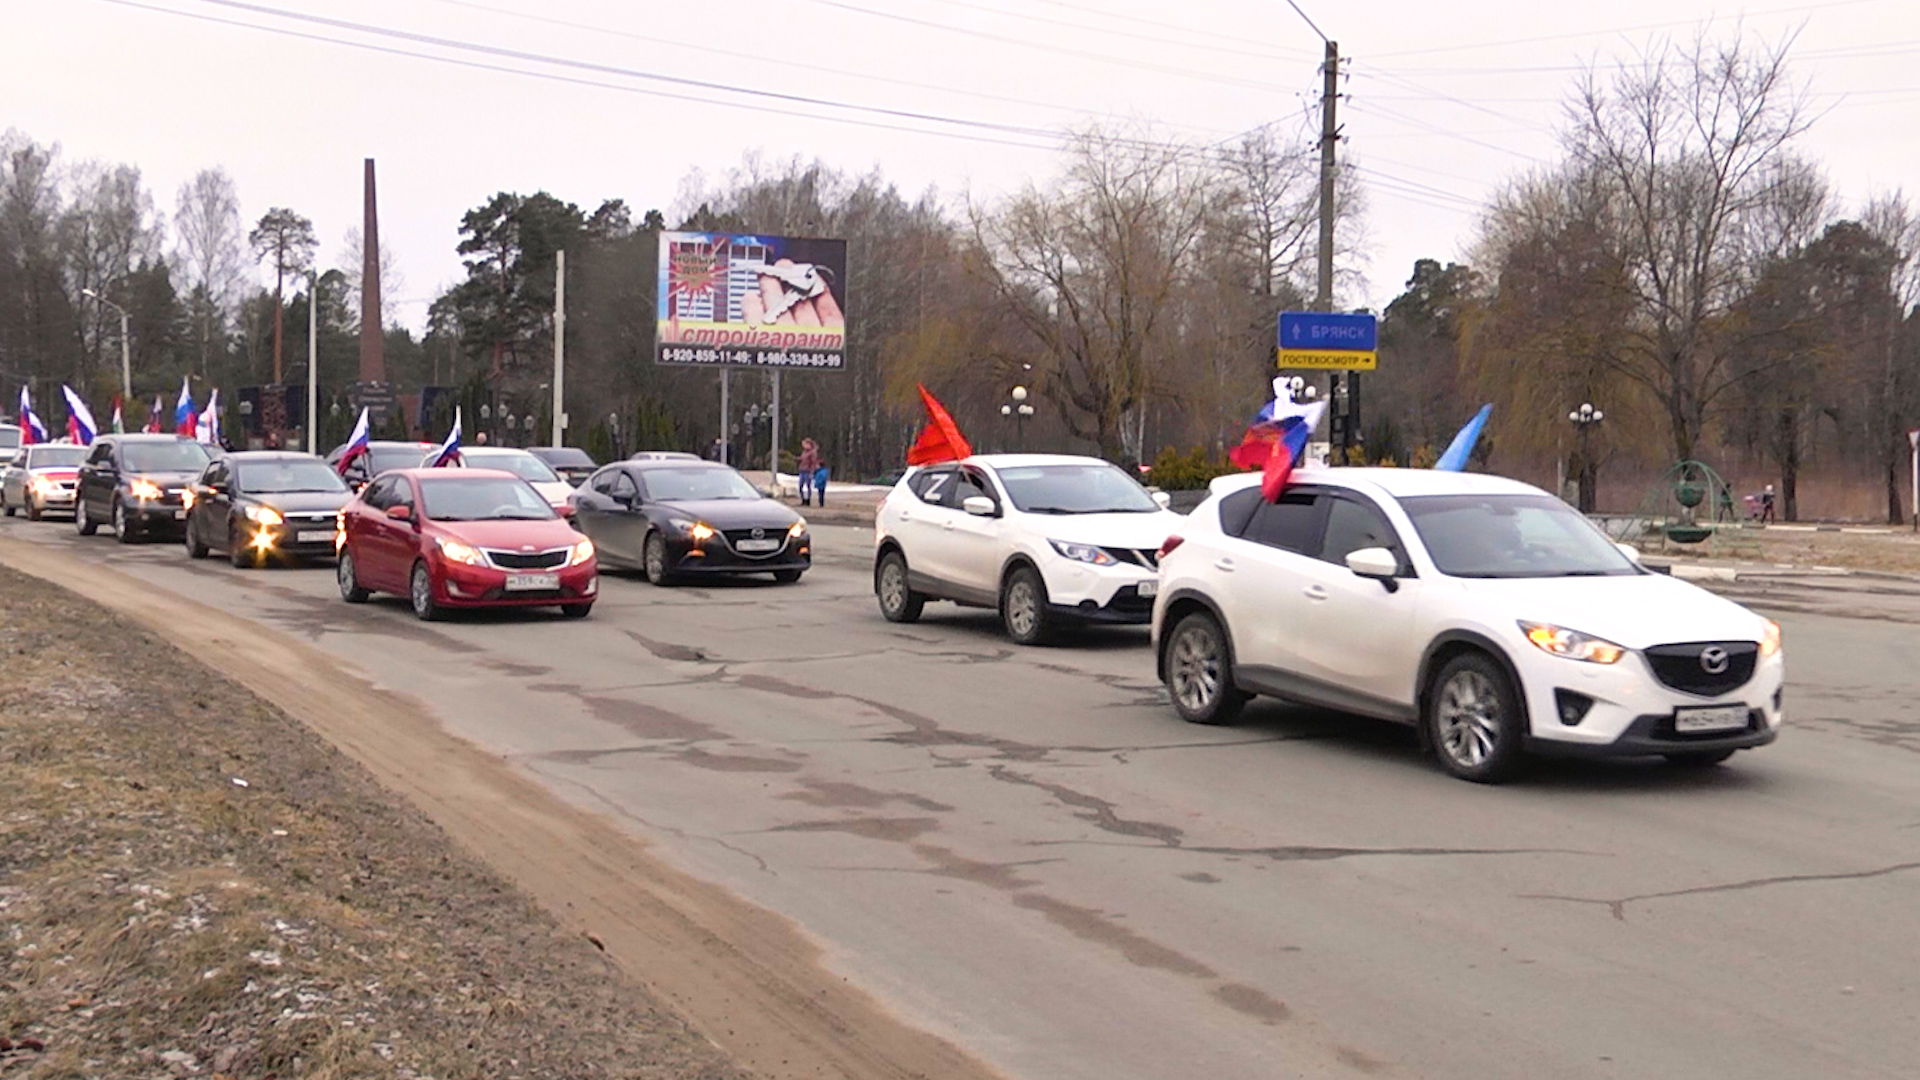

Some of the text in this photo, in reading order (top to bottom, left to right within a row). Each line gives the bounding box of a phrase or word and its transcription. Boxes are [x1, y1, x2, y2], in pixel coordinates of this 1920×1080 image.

[682, 325, 842, 350] стройгарант
[1311, 325, 1366, 339] БРЯНСК
[1283, 354, 1360, 365] ГОСТЕХОСМОТР
[924, 473, 950, 500] Z
